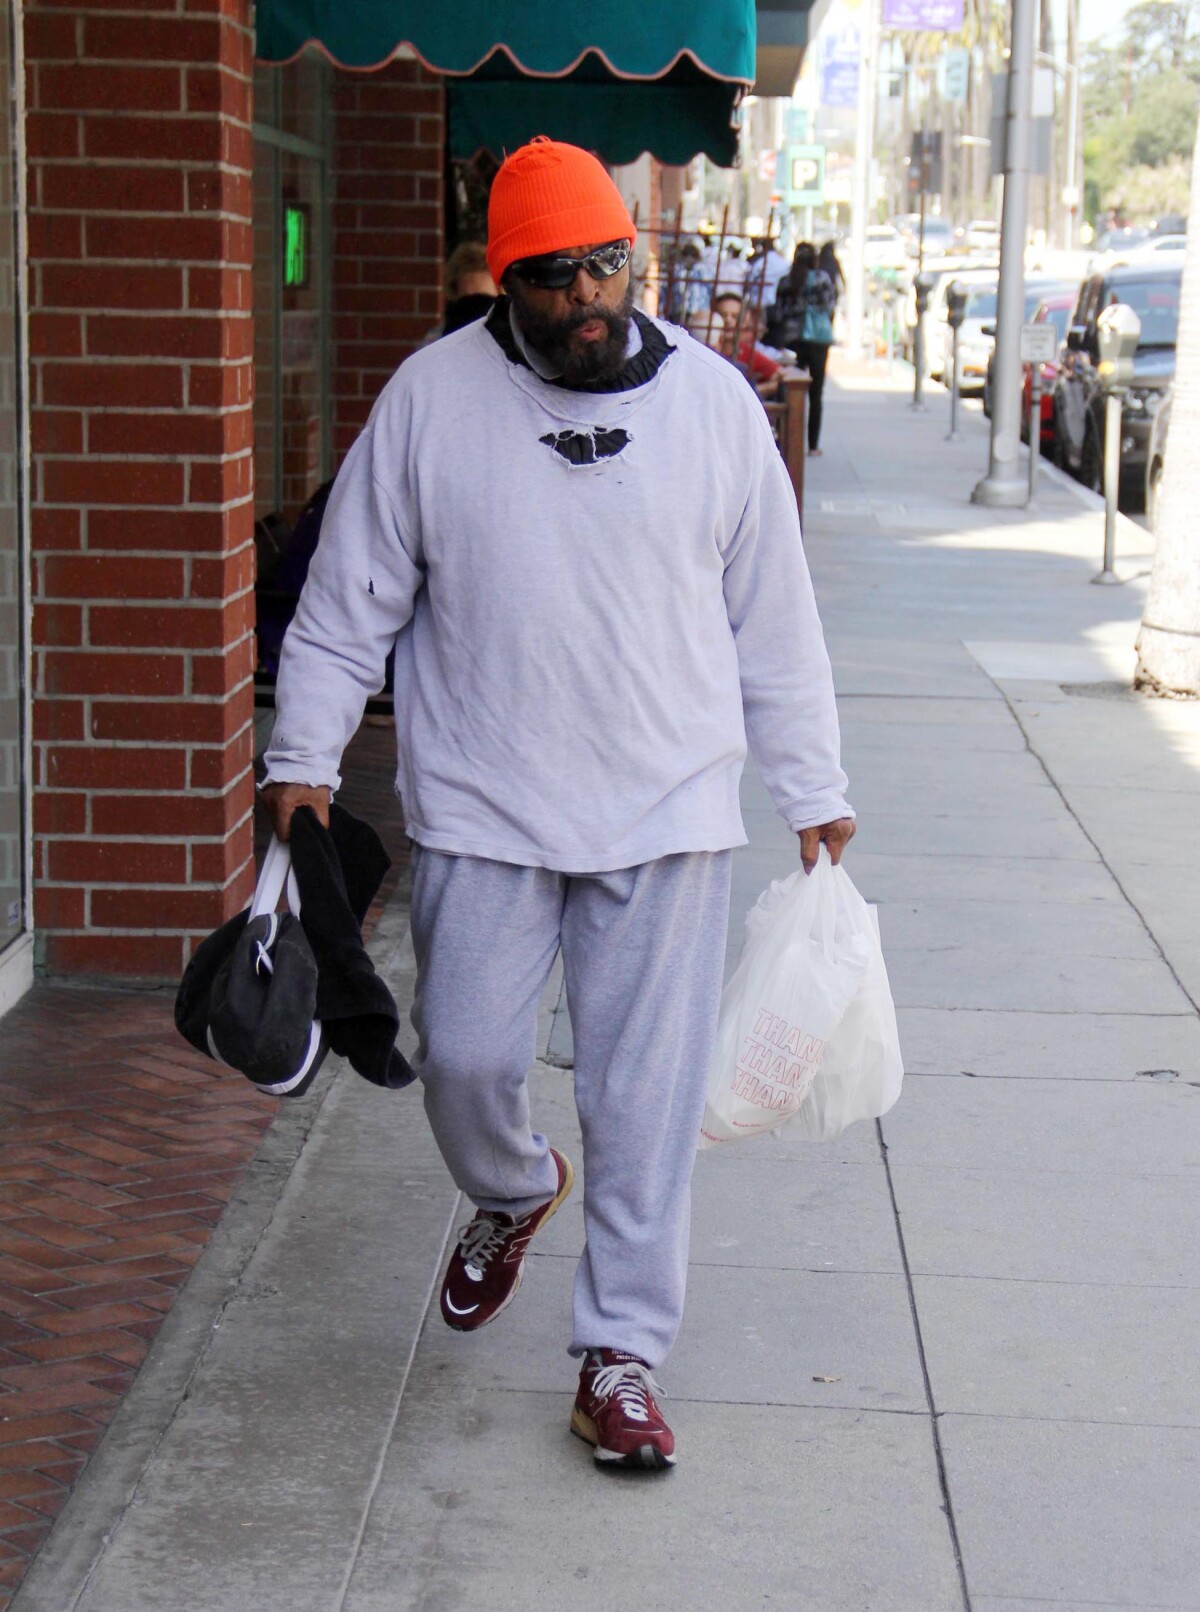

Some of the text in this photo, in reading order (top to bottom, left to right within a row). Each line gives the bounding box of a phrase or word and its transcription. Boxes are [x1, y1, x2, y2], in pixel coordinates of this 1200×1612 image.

[793, 160, 818, 189] P
[753, 1007, 828, 1063] THAN
[740, 1035, 811, 1090] THAN
[730, 1066, 799, 1112] THAN
